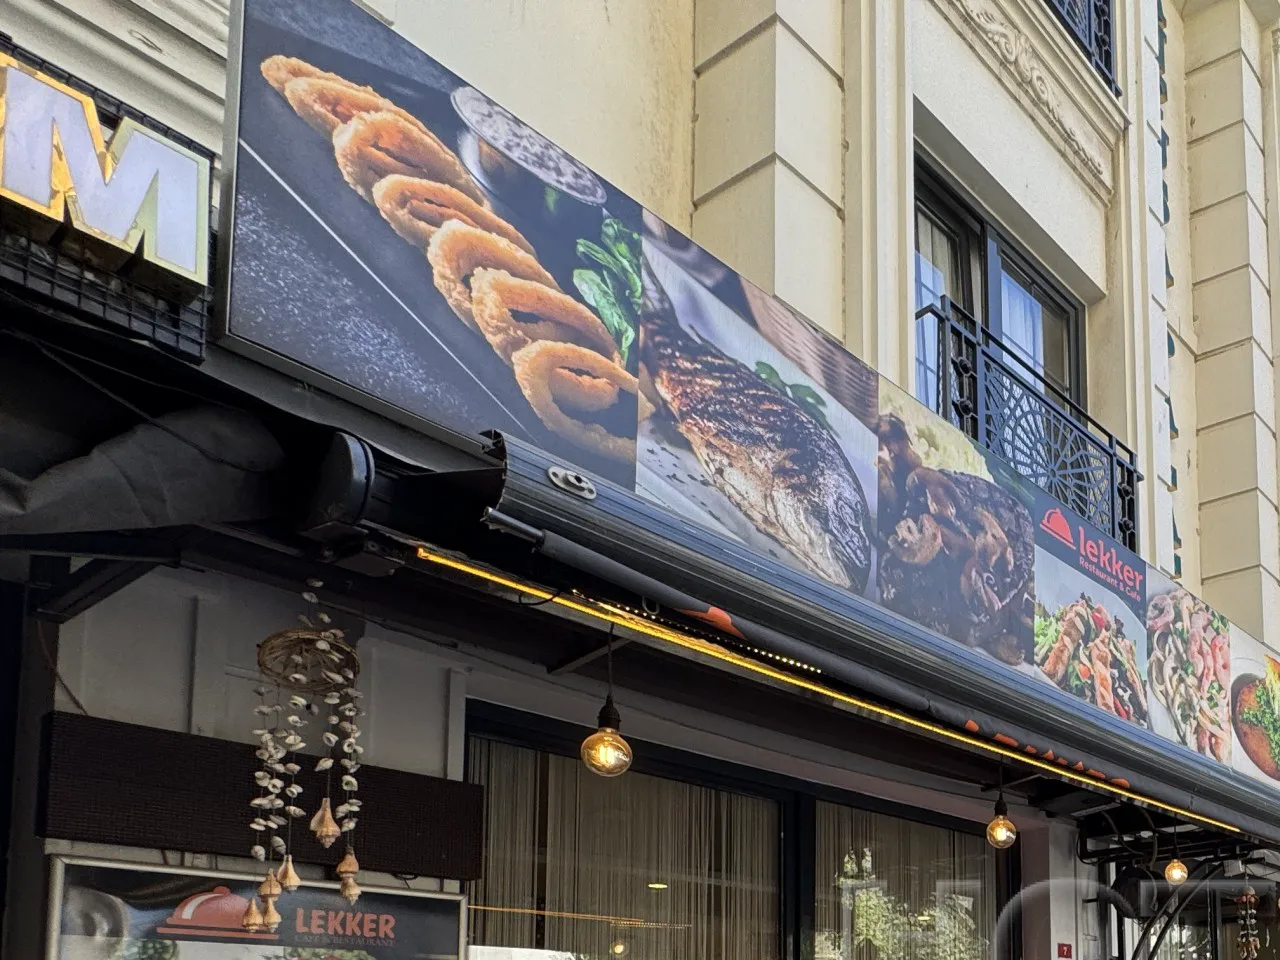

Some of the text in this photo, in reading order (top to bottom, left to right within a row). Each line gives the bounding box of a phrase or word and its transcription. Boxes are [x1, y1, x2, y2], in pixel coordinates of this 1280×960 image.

[1078, 525, 1144, 591] lekker
[1078, 556, 1141, 602] Restaurant & Cafe
[295, 907, 397, 940] LEKKER
[1063, 947, 1068, 956] 7
